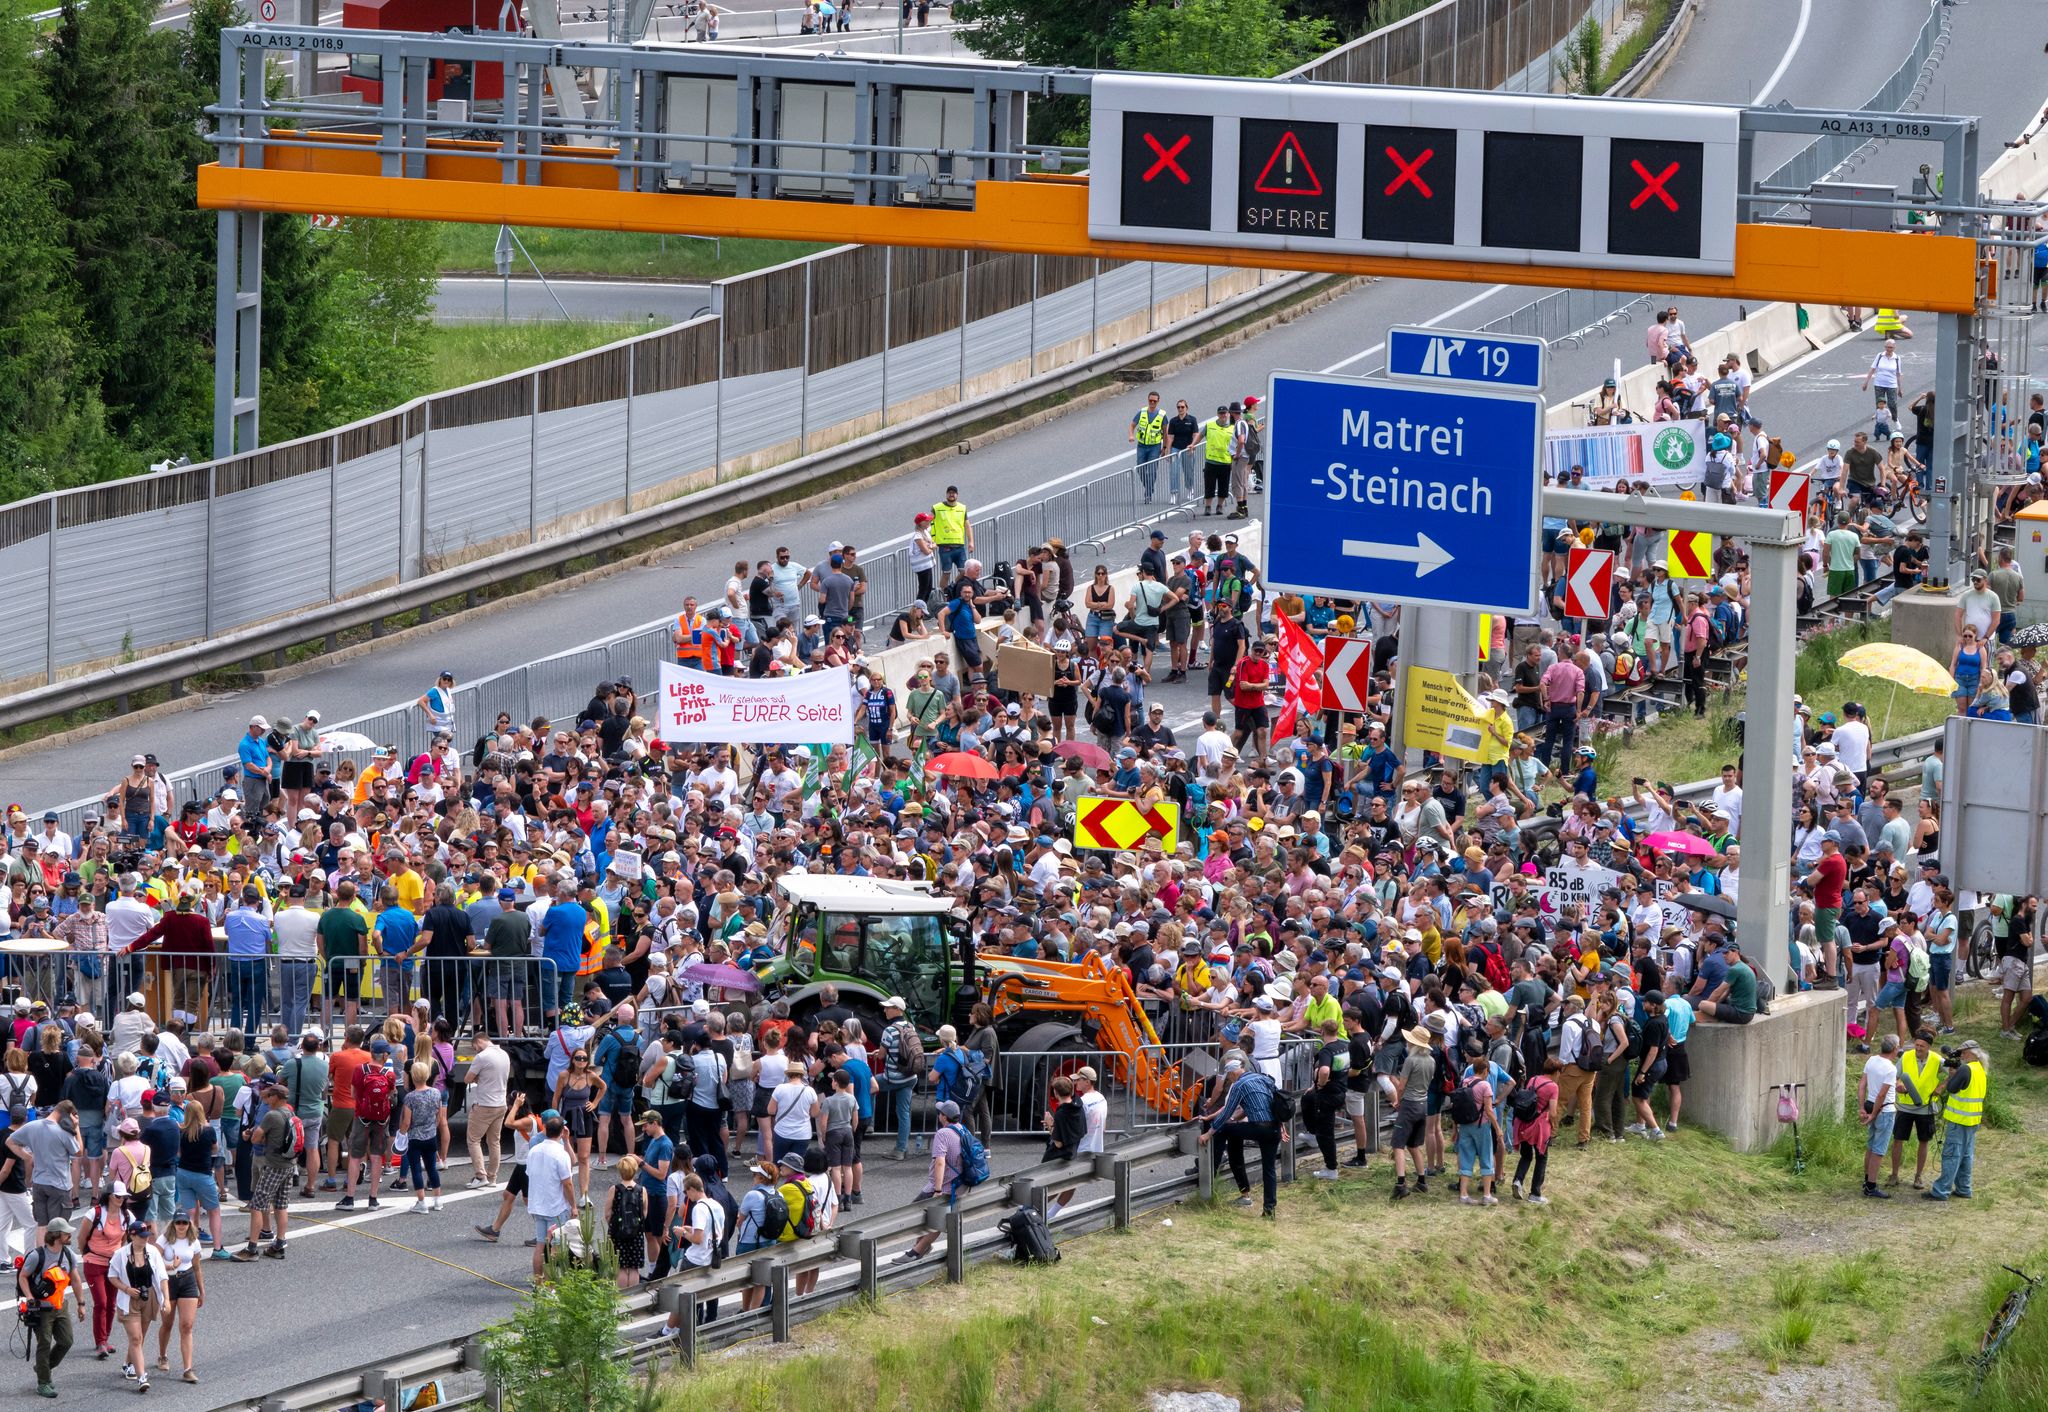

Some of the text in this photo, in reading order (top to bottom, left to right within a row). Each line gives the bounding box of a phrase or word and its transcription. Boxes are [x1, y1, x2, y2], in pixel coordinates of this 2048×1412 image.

[243, 33, 344, 50] AQ_A13_2_018,9
[1820, 119, 1930, 137] AQ_A13_1_018,9
[1247, 207, 1329, 230] SPERRE
[1477, 345, 1510, 377] 19
[1341, 408, 1464, 457] Matrei
[1311, 462, 1492, 515] -Steinach
[669, 682, 705, 697] Liste
[1422, 680, 1443, 692] Mensch
[679, 696, 716, 710] Fritz.
[719, 694, 786, 704] Wir stehen auf
[1424, 694, 1438, 703] NEIN
[673, 709, 707, 726] Tirol
[731, 703, 843, 722] EURER Seite!
[1549, 871, 1584, 891] 85 dB
